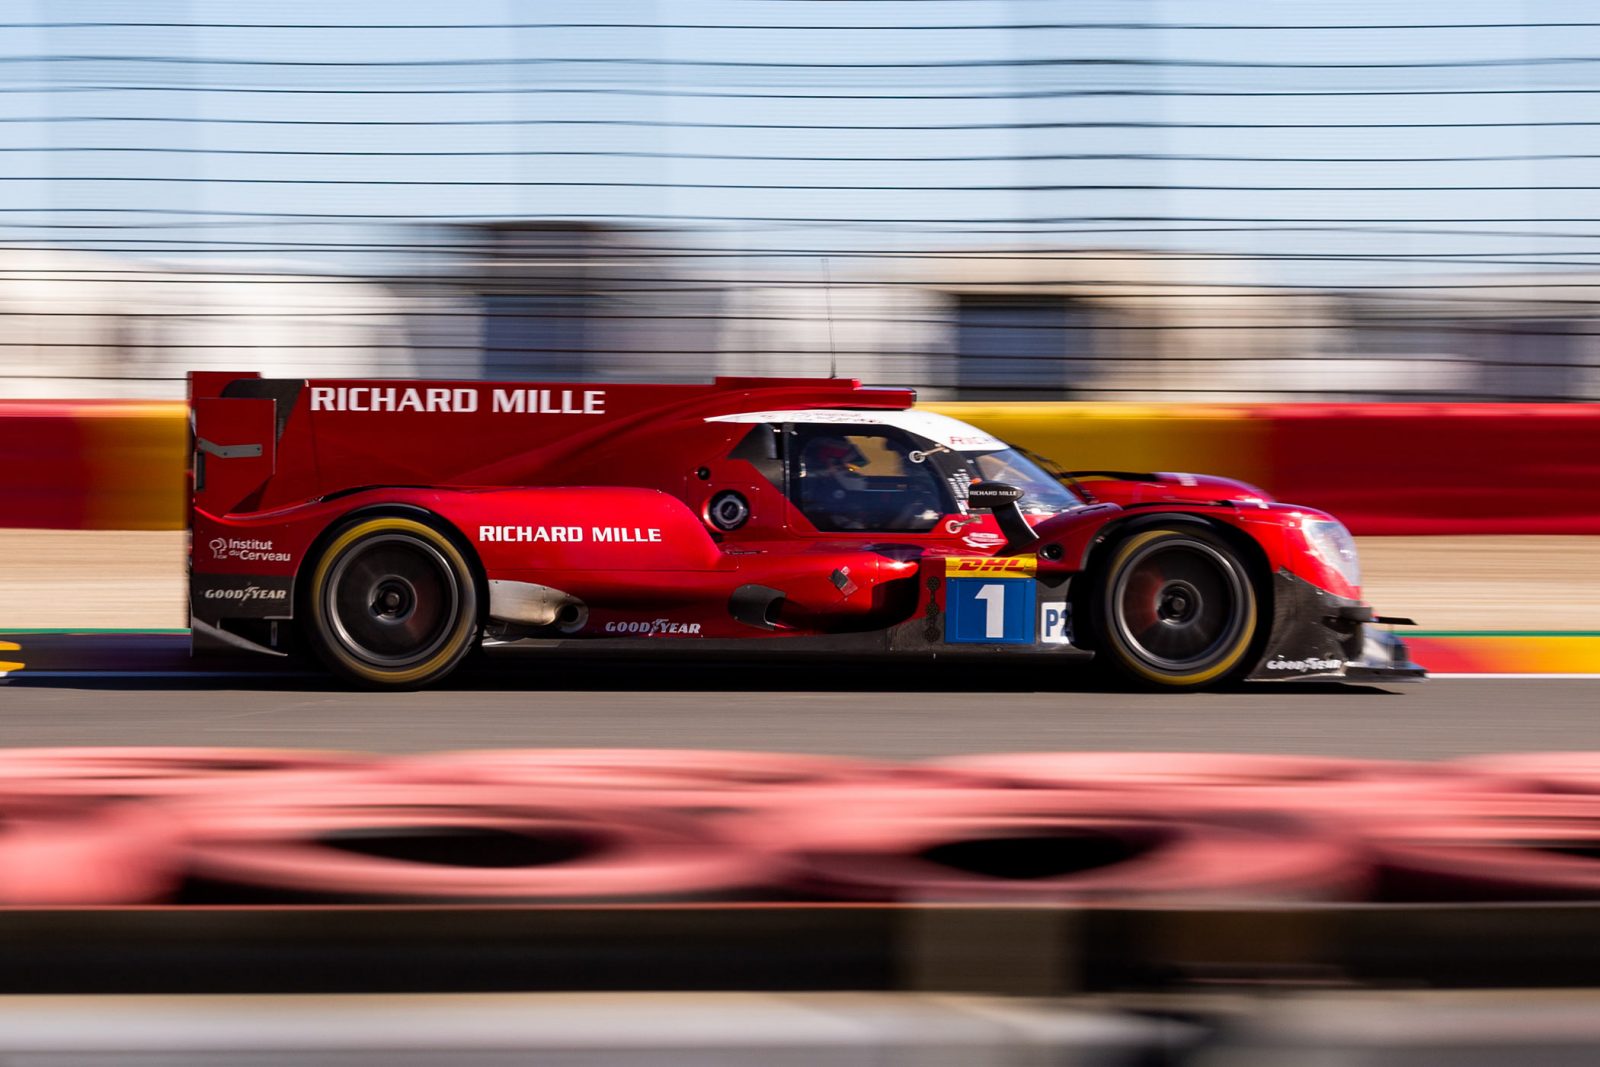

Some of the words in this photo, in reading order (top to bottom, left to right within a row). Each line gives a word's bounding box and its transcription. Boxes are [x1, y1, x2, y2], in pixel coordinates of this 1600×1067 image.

[310, 387, 479, 413] RICHARD
[492, 388, 606, 415] MILLE
[479, 525, 583, 542] RICHARD
[592, 527, 662, 543] MILLE
[228, 538, 273, 550] Institut
[240, 549, 291, 561] Cerveau
[958, 558, 1025, 572] DHL
[205, 586, 287, 601] GOODYEAR
[974, 584, 1005, 638] 1
[605, 619, 701, 636] GOODYEAR
